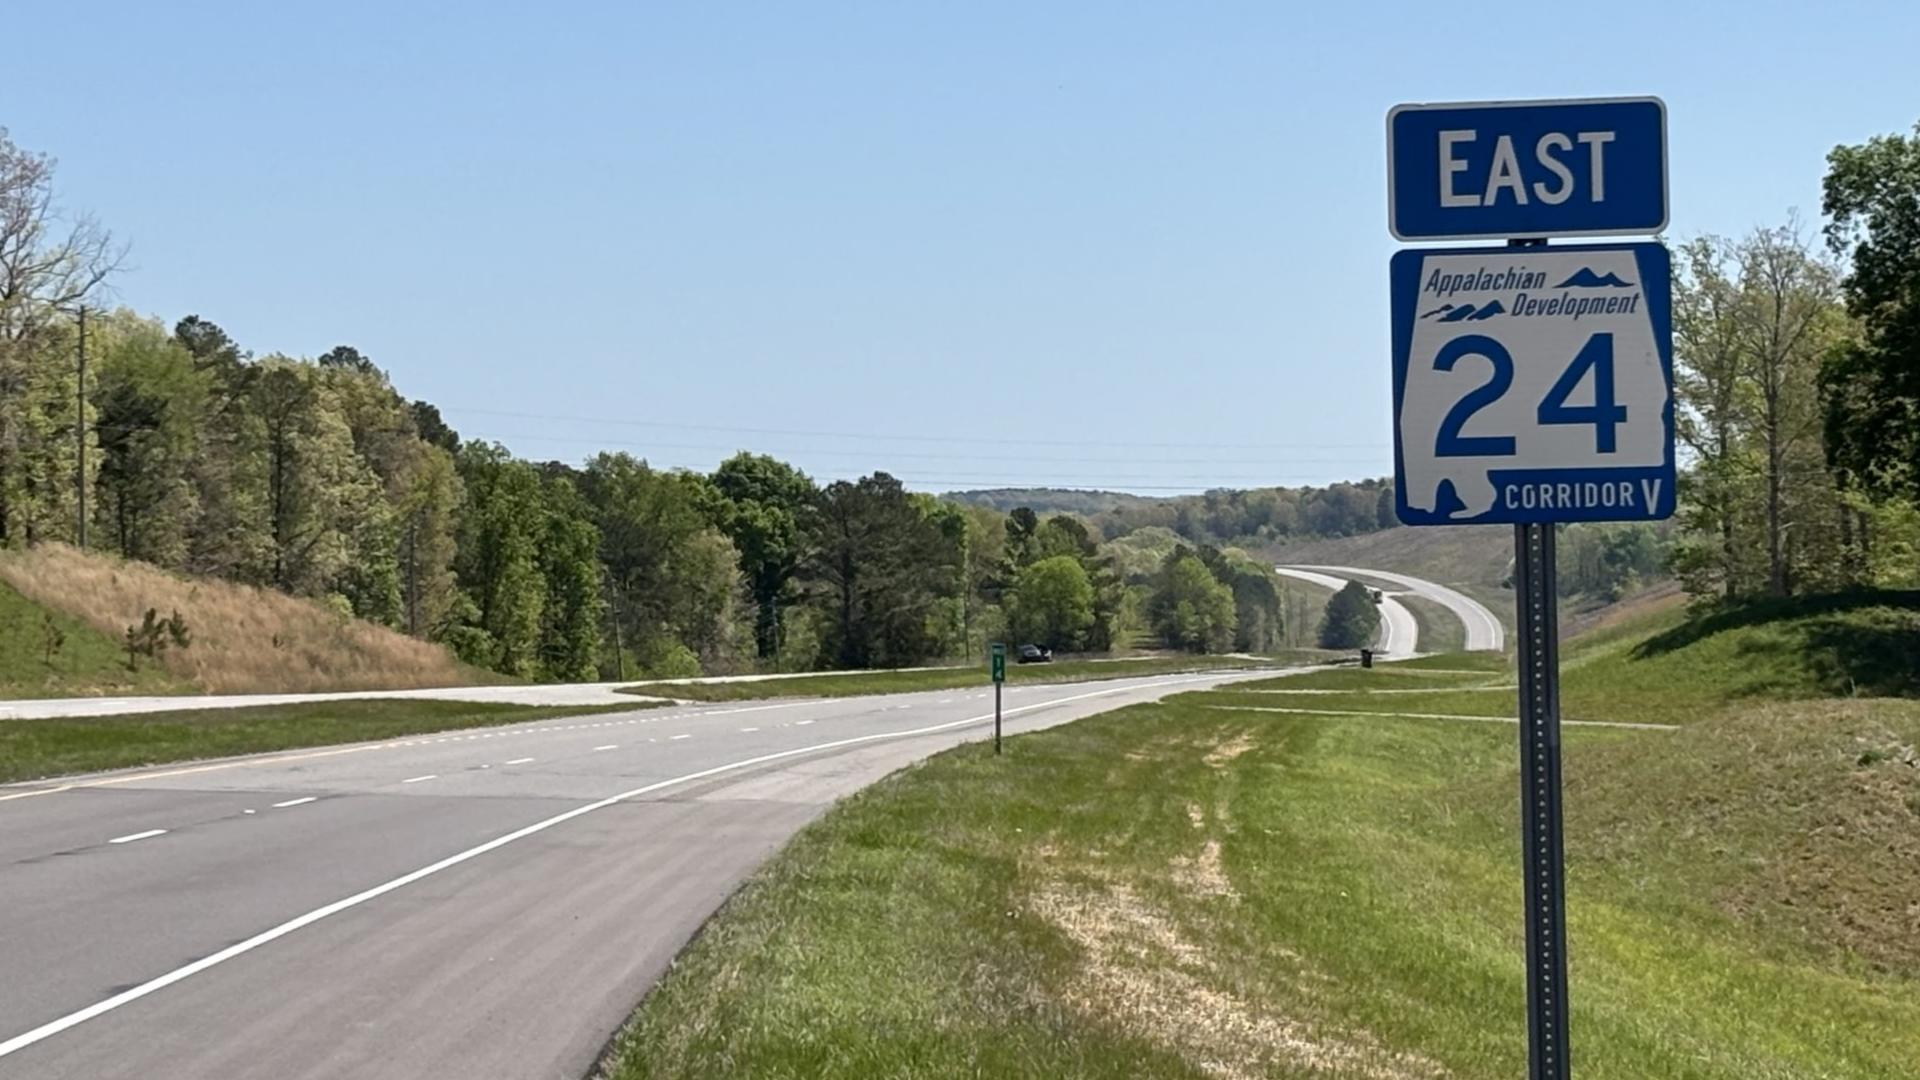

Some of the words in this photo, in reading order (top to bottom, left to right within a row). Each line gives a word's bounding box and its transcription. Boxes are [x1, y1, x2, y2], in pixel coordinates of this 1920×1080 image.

[1439, 130, 1616, 207] EAST
[1425, 267, 1546, 297] Appalachian
[1511, 293, 1640, 321] Development
[1432, 332, 1627, 457] 24
[1505, 482, 1635, 510] CORRIDOR
[1641, 478, 1662, 515] V
